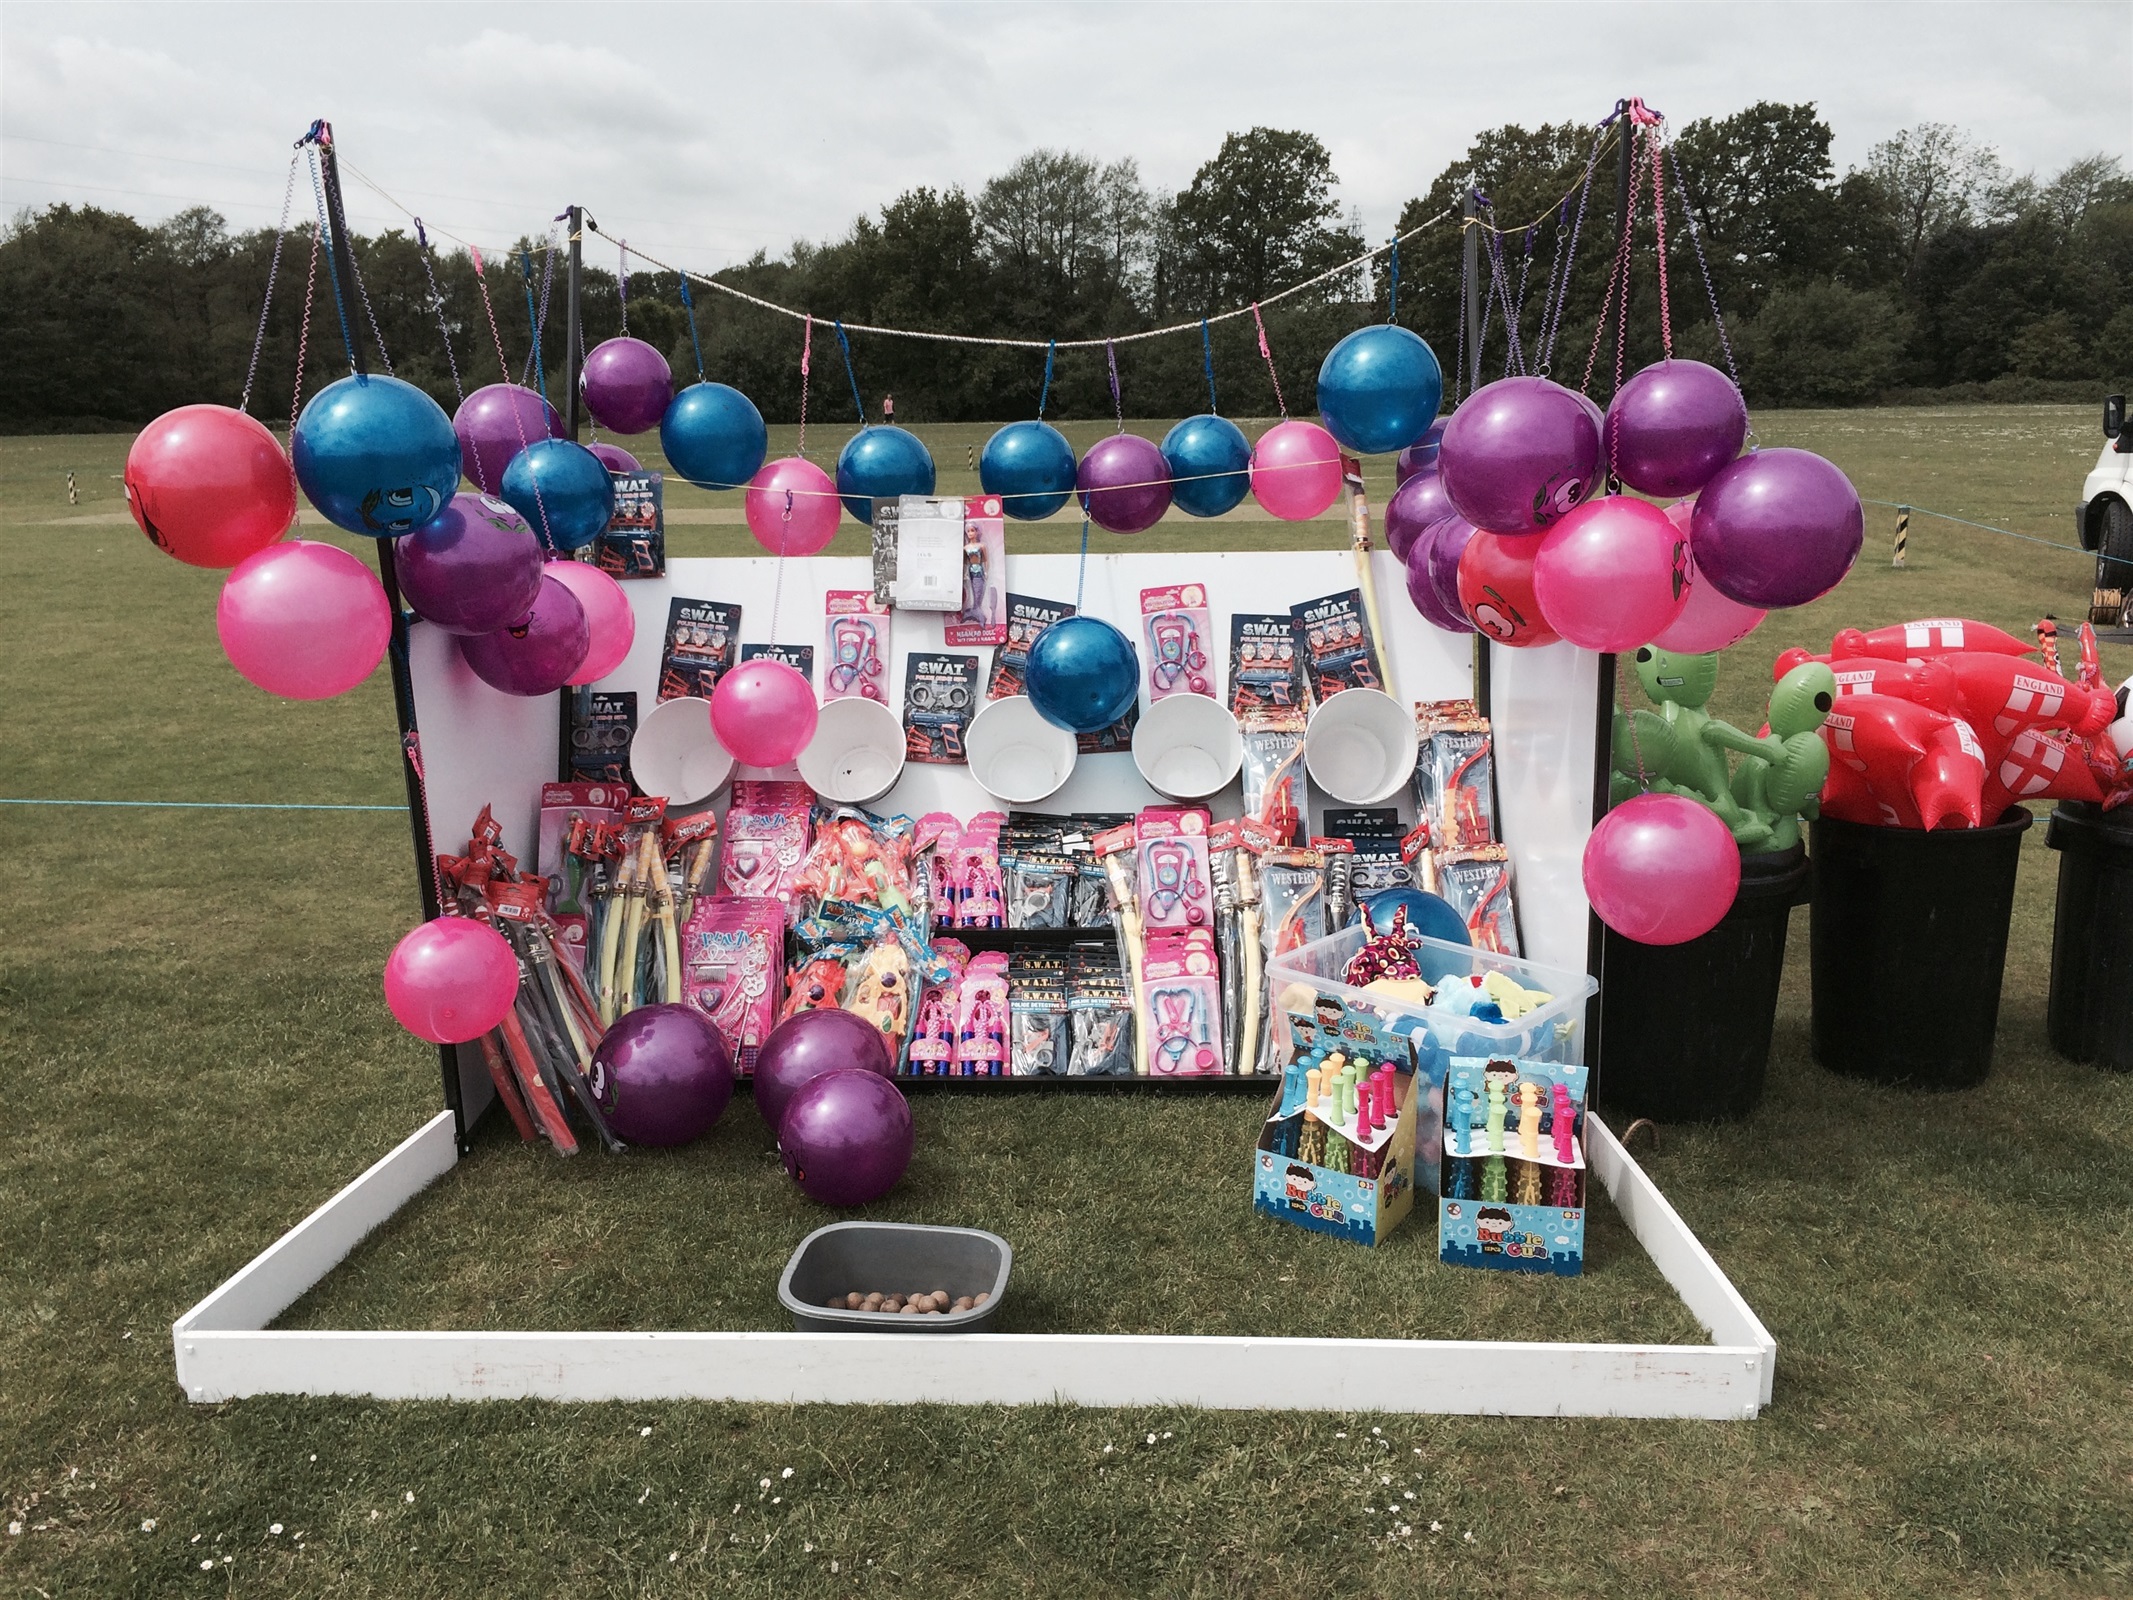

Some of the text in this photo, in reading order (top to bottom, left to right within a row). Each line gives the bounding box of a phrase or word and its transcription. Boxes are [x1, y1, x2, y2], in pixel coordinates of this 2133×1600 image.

[680, 607, 727, 624] S.W.A.T.
[1243, 623, 1290, 637] S.W.A.T.
[918, 661, 965, 675] S.W.A.T.
[2016, 677, 2063, 696] ENGLAND
[1254, 737, 1297, 751] WESTERN
[1441, 737, 1484, 749] WESTERN
[1271, 871, 1317, 885] WESTERN
[1453, 866, 1500, 882] WESTERN
[1025, 961, 1062, 969] S.W.A.T.
[1023, 992, 1061, 1000] S.W.A.T.
[1083, 990, 1121, 998] S.W.A.T.
[1285, 1183, 1342, 1210] Bubble
[1310, 1203, 1345, 1224] Gun
[1477, 1227, 1544, 1246] Bubble
[1506, 1243, 1548, 1259] Gun
